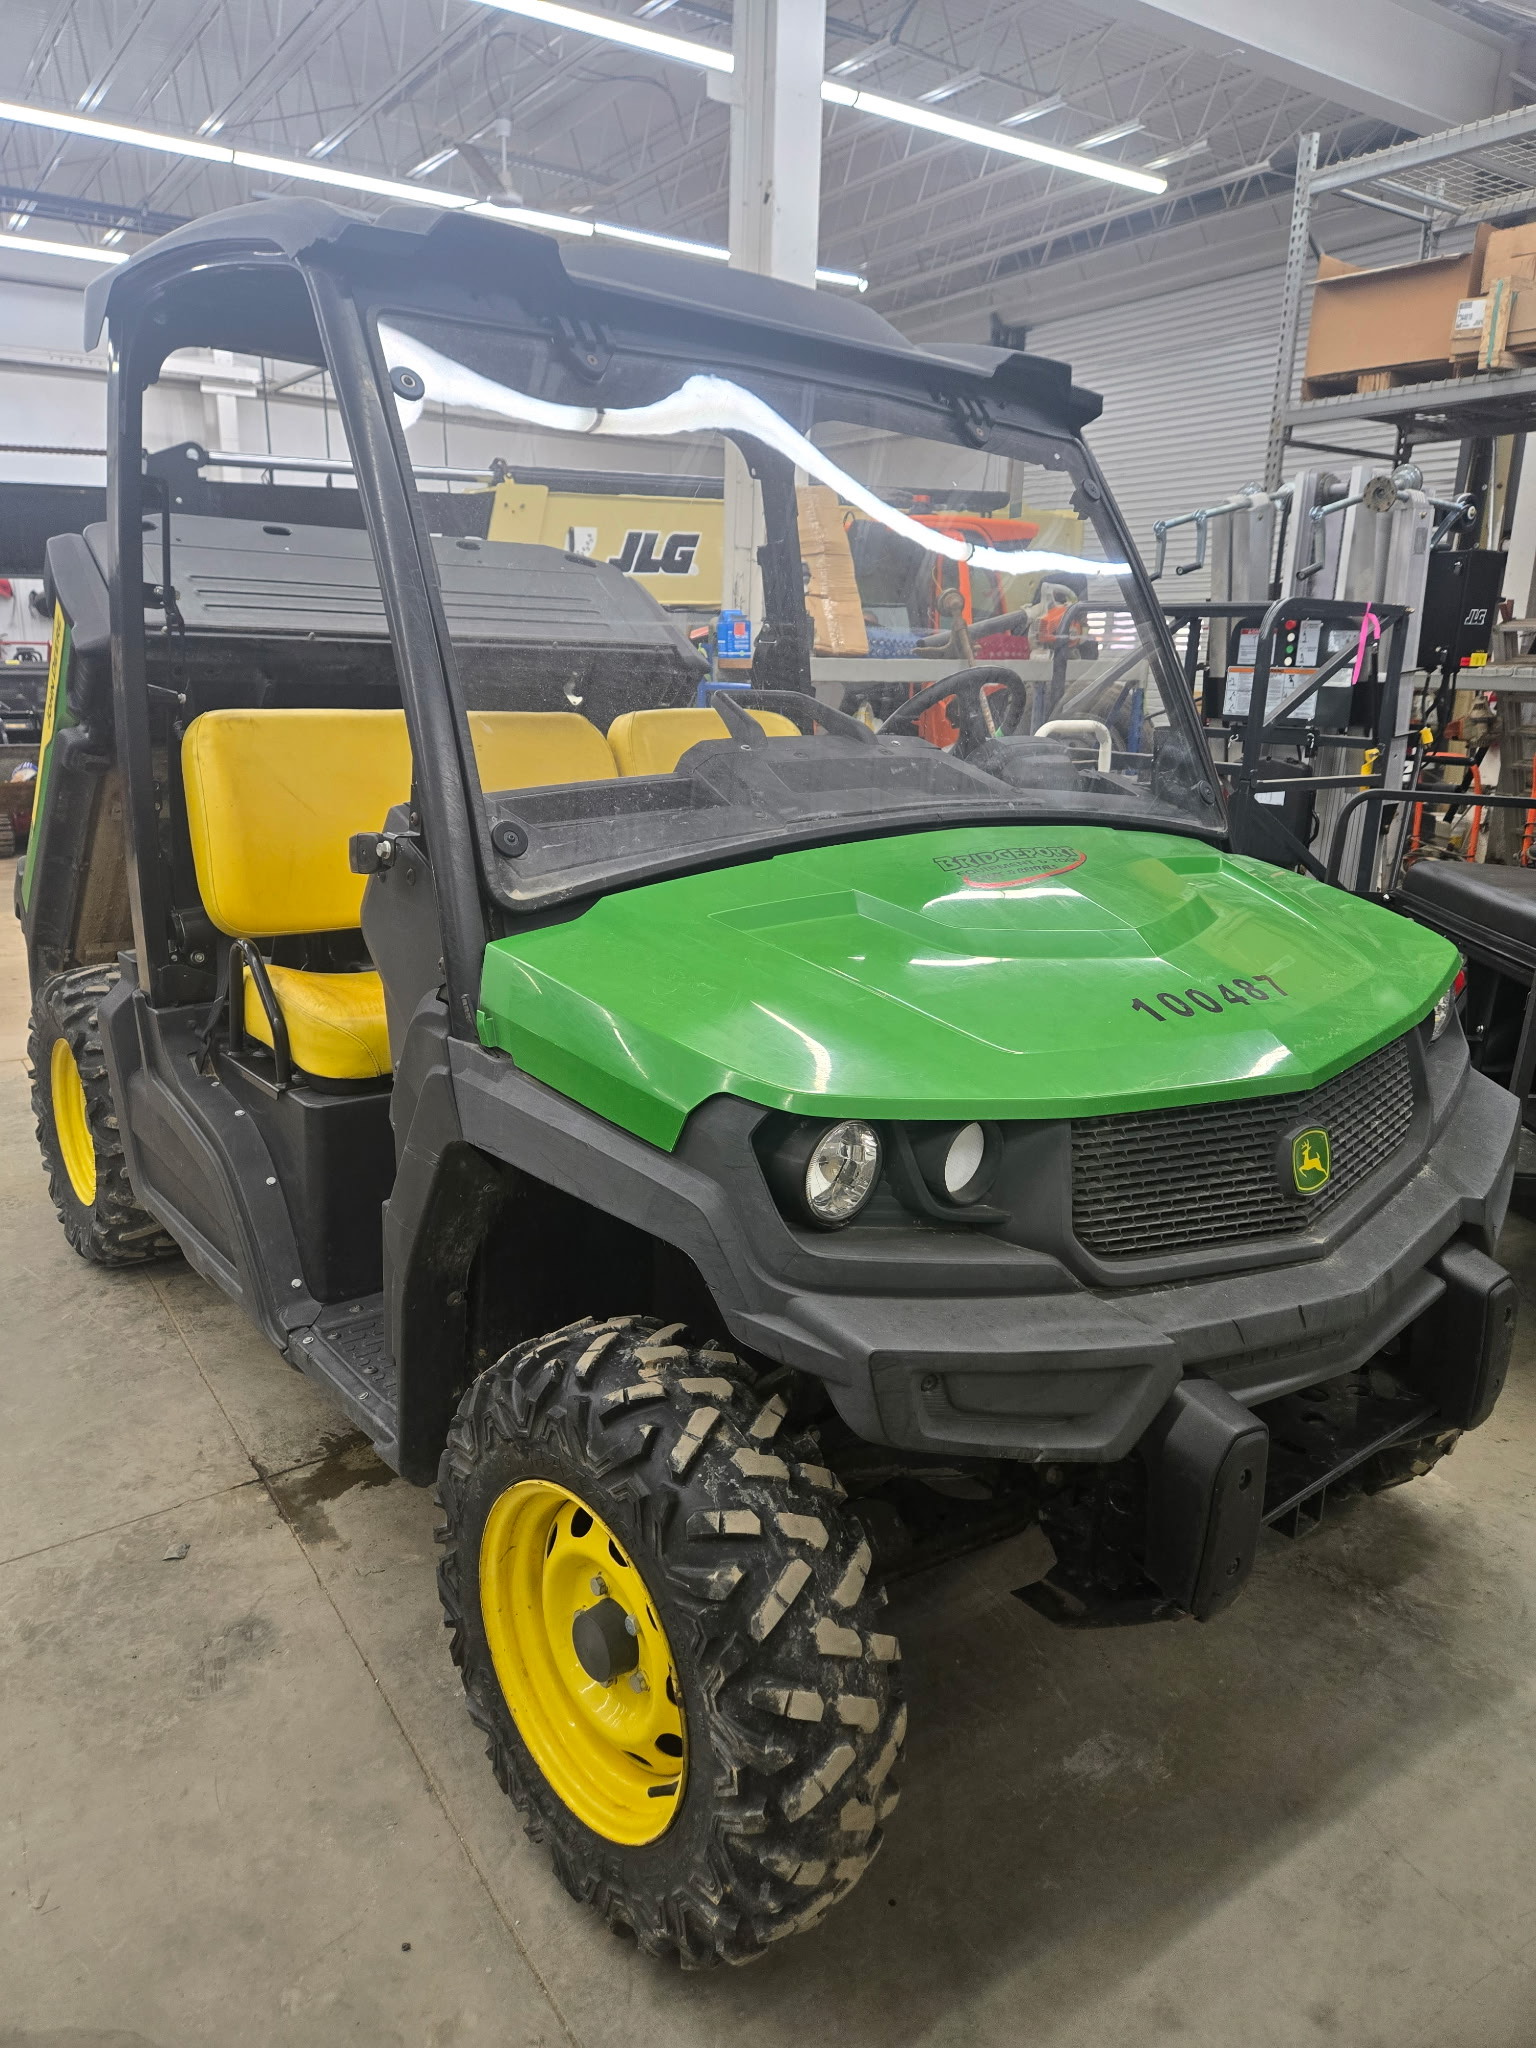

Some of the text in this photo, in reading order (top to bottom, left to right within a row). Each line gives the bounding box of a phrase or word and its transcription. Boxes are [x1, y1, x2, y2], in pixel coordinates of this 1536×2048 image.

[607, 531, 701, 574] JLG
[1464, 609, 1487, 625] JLG
[933, 846, 1078, 871] BRIDGEPORT
[1131, 975, 1288, 1022] 100487
